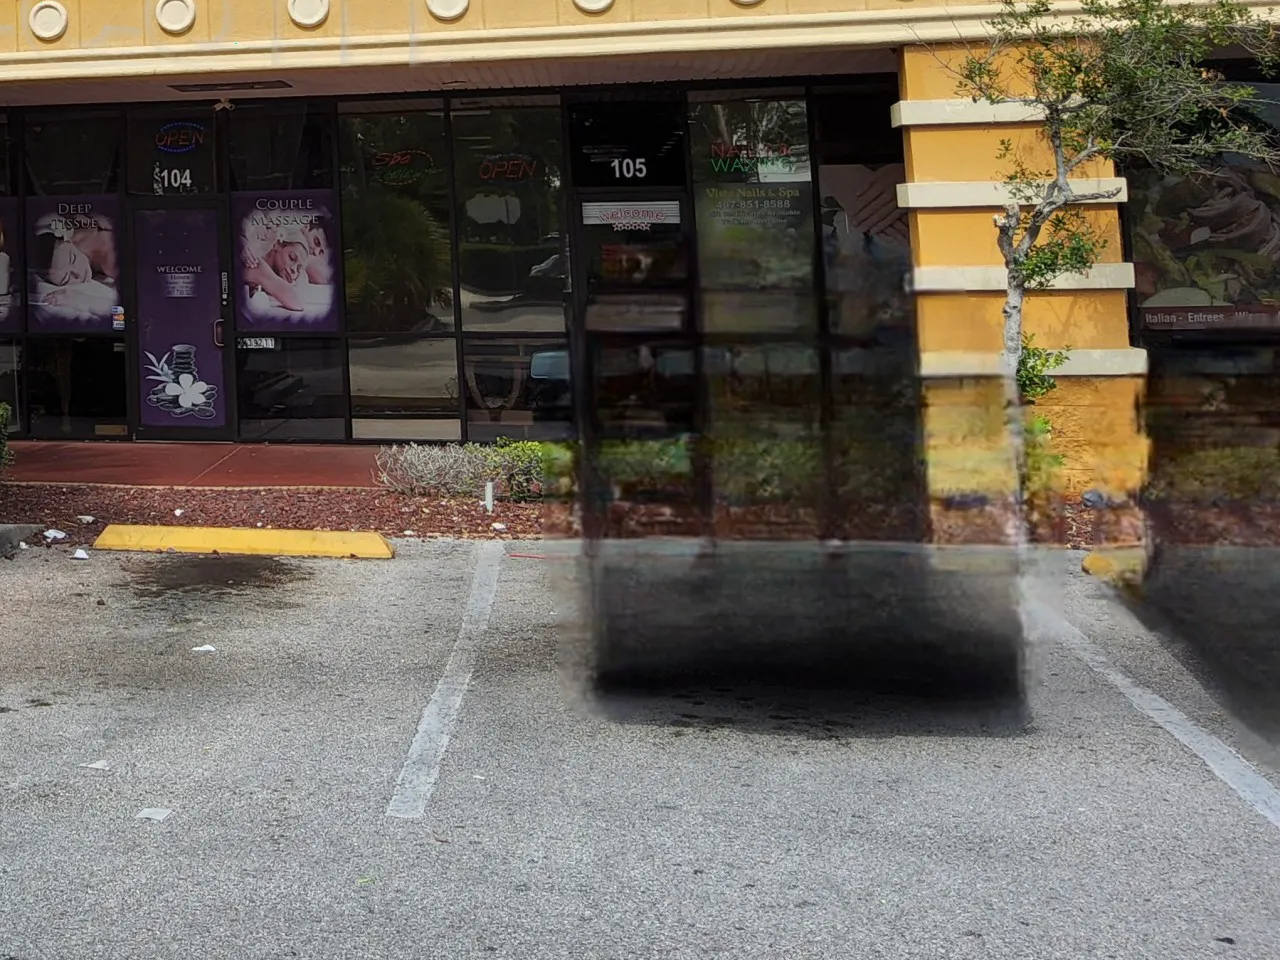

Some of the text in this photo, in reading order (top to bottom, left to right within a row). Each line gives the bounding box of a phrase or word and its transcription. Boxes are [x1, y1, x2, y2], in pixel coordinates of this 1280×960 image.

[155, 130, 205, 147] OPEN
[478, 160, 537, 180] OPEN
[610, 157, 647, 179] 105
[160, 168, 193, 188] 104
[778, 187, 800, 198] Spa
[58, 203, 93, 215] DEEP
[255, 198, 313, 211] COUPLE
[251, 214, 320, 226] MASSAGE
[597, 207, 665, 224] welcome
[50, 218, 98, 230] TISSUE
[156, 265, 203, 274] WELCOME
[1188, 312, 1225, 323] Entrees
